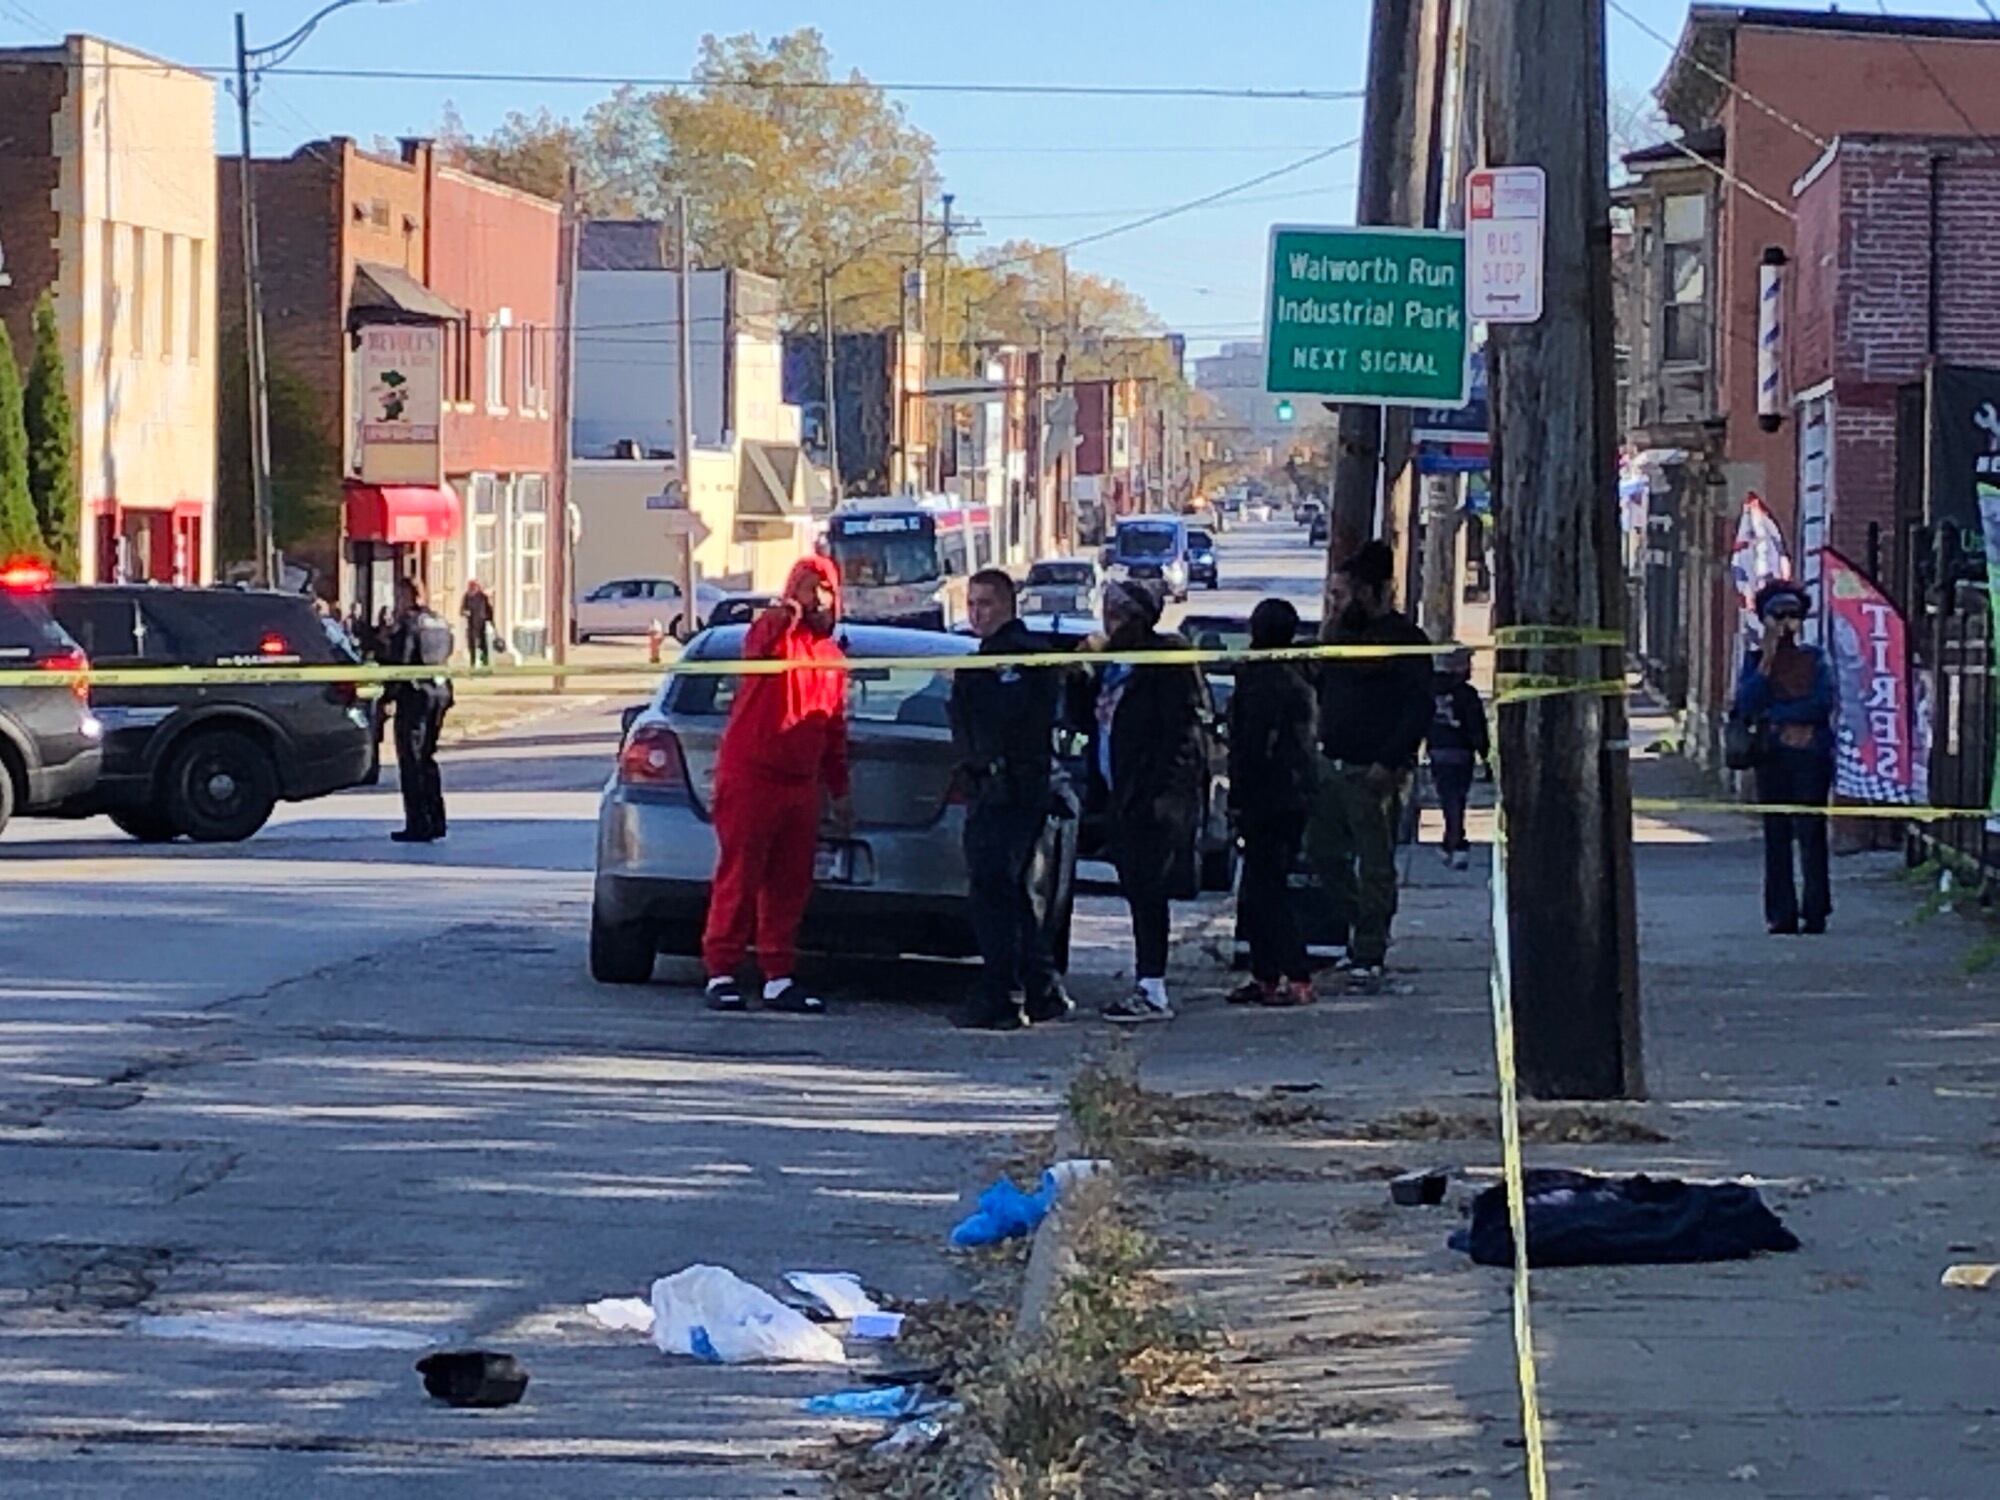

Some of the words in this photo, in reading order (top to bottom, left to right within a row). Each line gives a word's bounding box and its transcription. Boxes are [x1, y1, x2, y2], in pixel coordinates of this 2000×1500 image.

[1486, 231, 1522, 255] BUS
[1289, 252, 1398, 284] Walworth
[1408, 257, 1455, 286] Run
[1482, 262, 1526, 285] STOP
[1279, 296, 1394, 327] Industrial
[1405, 300, 1460, 331] Park
[1293, 346, 1347, 371] NEXT
[1360, 349, 1438, 376] SIGNAL
